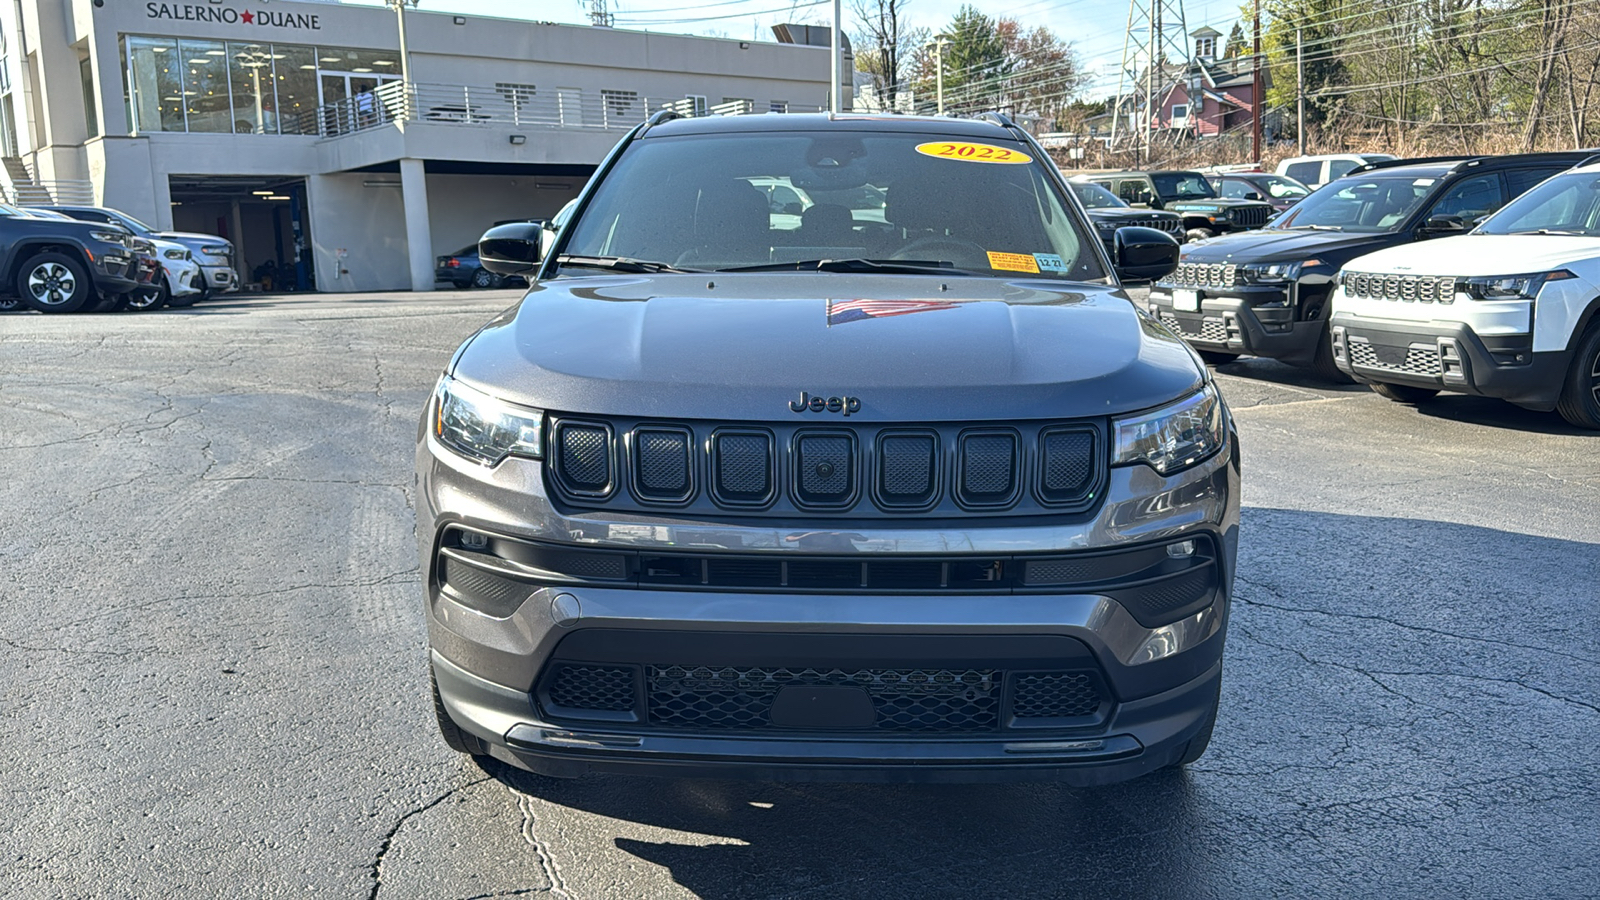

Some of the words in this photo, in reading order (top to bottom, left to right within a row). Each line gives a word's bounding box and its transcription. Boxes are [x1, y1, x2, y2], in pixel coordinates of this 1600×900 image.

[146, 2, 238, 24] SALERNO
[257, 10, 321, 30] DUANE
[938, 145, 1012, 160] 2022
[1051, 259, 1062, 267] 27
[788, 391, 861, 417] Jeep
